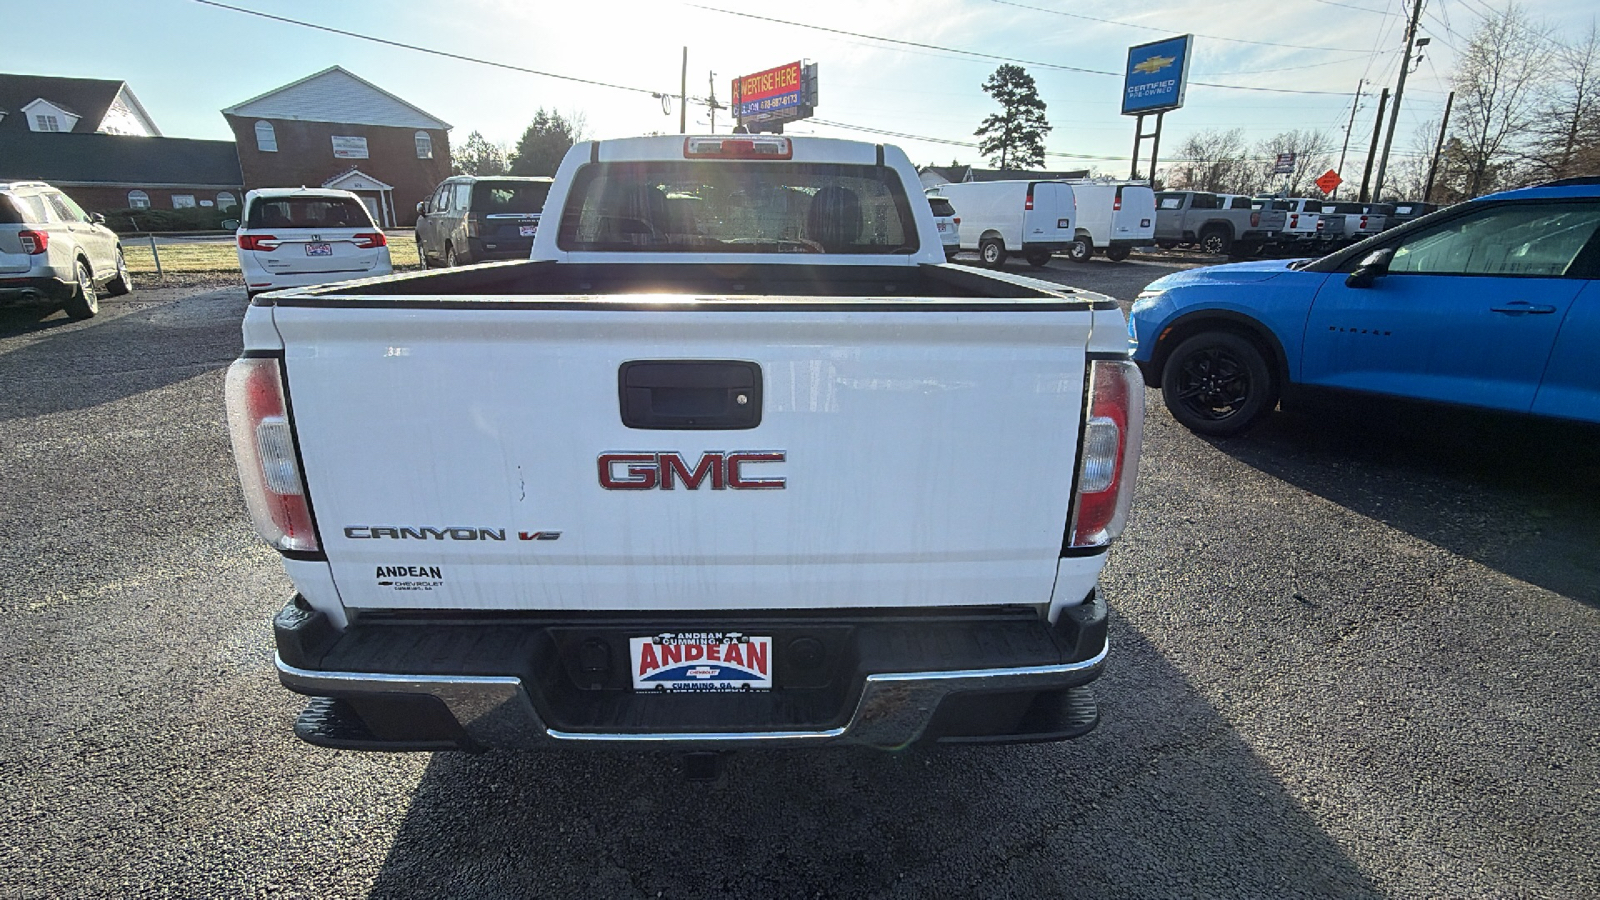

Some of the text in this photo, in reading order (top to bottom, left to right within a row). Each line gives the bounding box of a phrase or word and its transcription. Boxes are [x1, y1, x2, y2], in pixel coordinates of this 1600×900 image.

[733, 66, 797, 98] AVERTISE HERE
[1128, 80, 1175, 93] CERTIFIED
[1129, 87, 1172, 98] PRE-OWNED
[597, 450, 787, 490] GMC
[344, 525, 506, 541] CANYON
[376, 566, 442, 579] ANDEAN
[639, 642, 767, 677] ANDEAN
